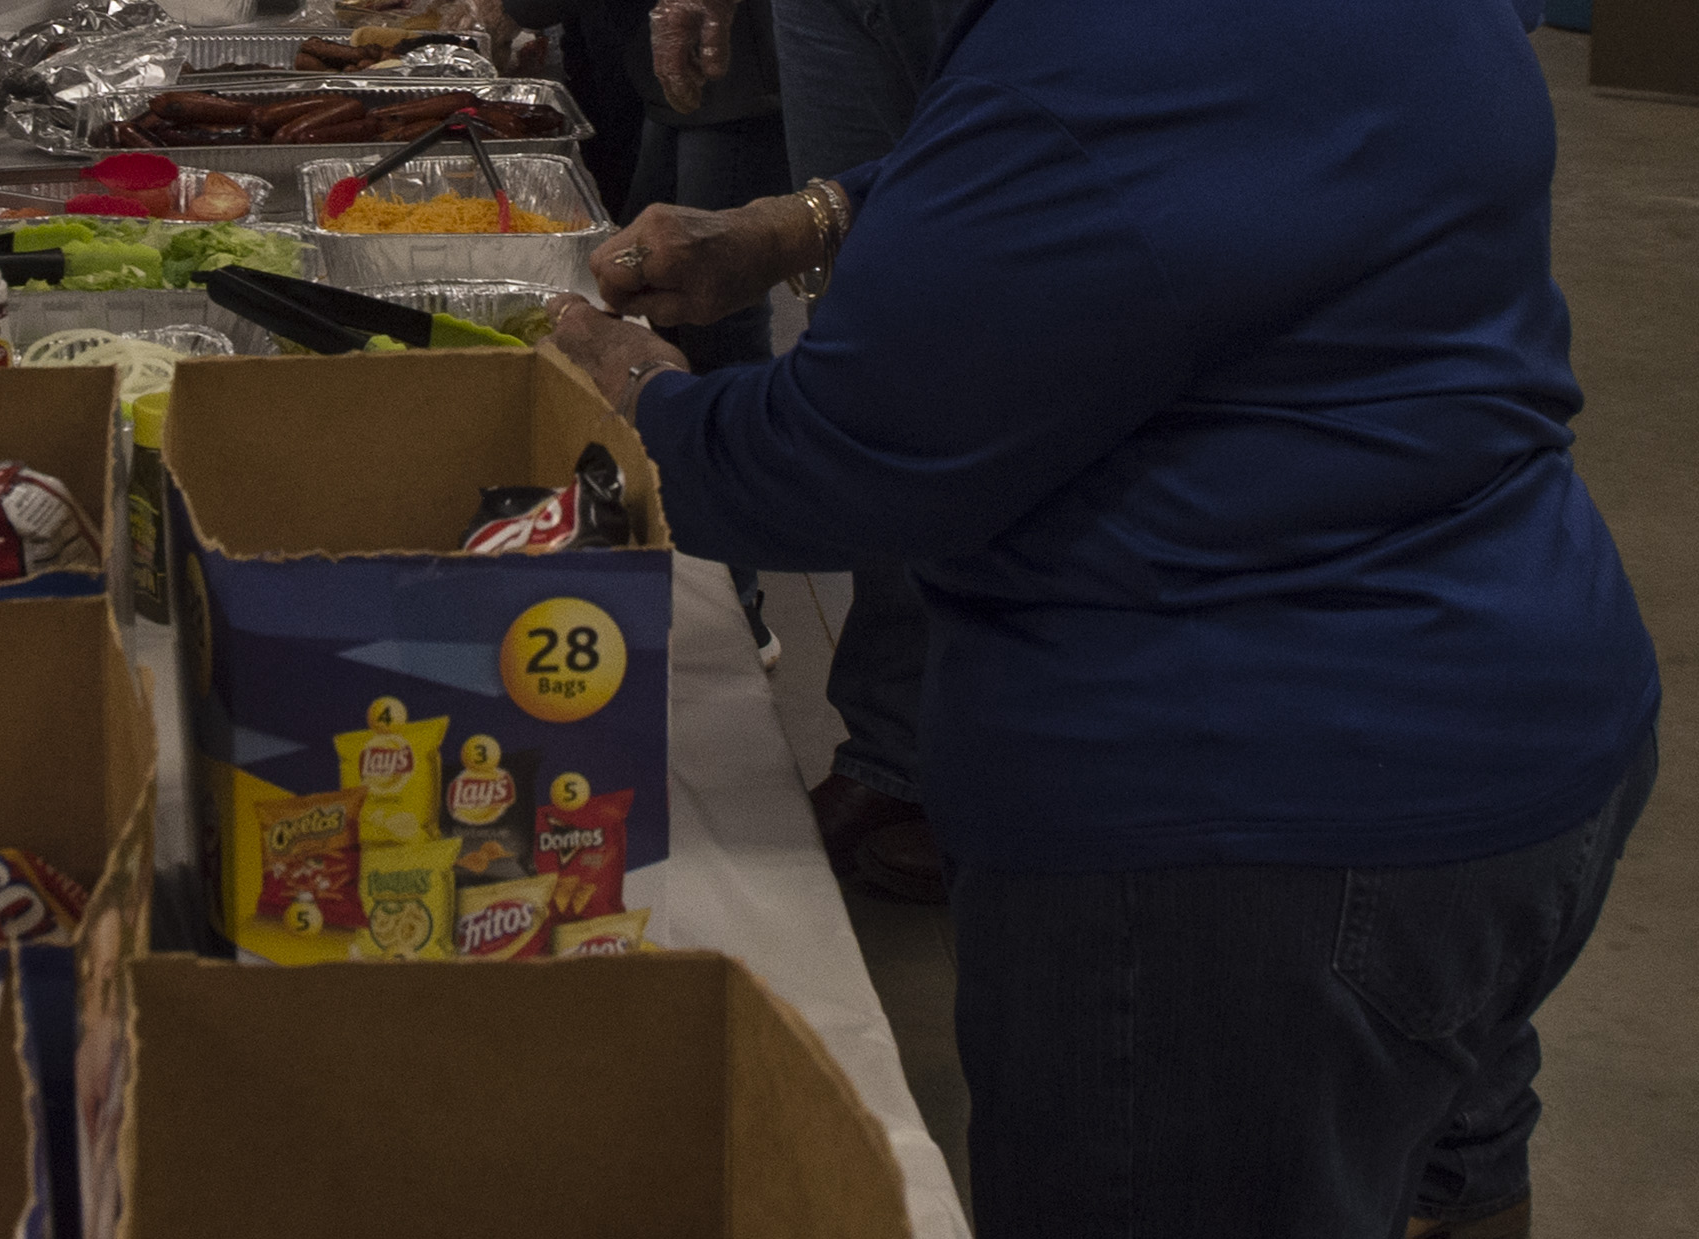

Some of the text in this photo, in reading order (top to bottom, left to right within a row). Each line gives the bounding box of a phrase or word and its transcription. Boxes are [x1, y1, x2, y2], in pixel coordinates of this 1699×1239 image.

[526, 626, 599, 673] 28
[538, 677, 586, 699] Bags
[377, 706, 392, 725] 4
[474, 744, 488, 765] 3
[563, 781, 578, 803] 5
[539, 827, 603, 852] Doritos
[296, 910, 310, 932] 5
[457, 903, 535, 955] Fritos
